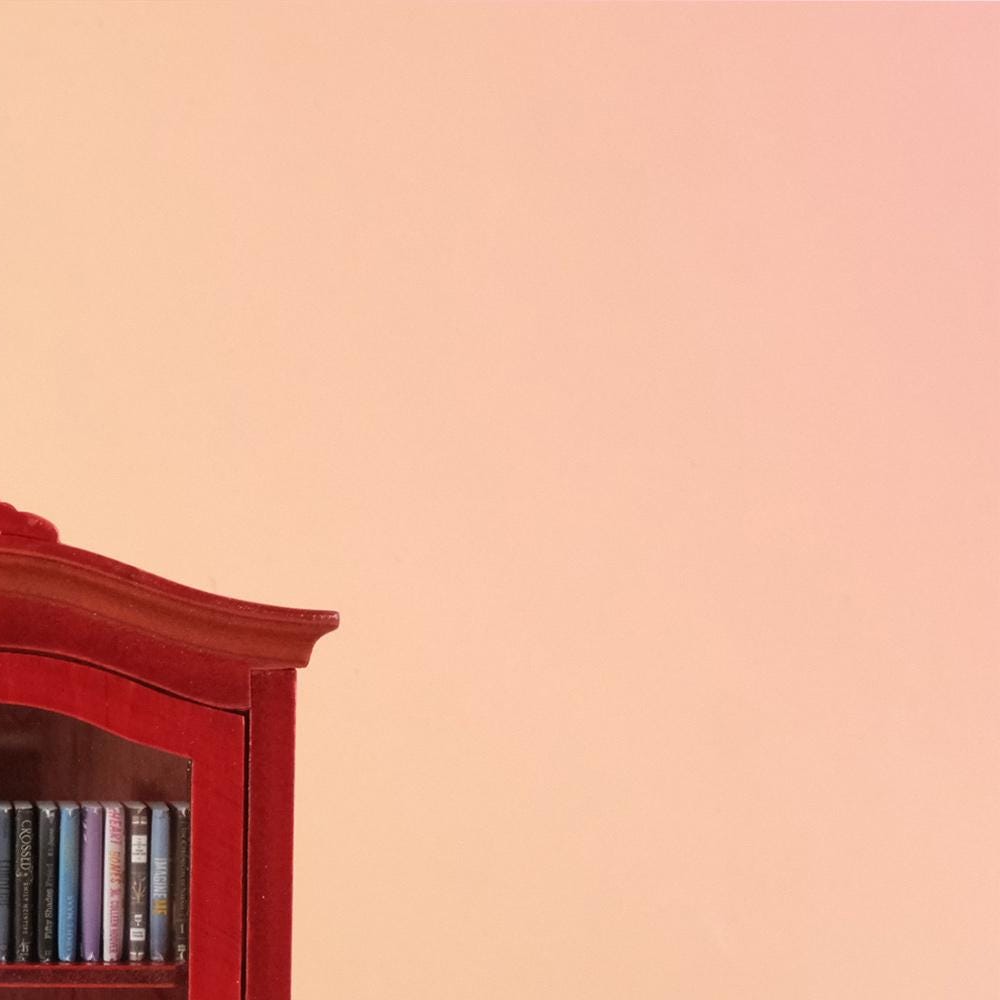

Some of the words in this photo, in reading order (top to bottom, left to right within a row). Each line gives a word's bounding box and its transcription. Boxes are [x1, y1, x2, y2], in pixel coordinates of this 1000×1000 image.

[109, 811, 121, 844] HEART
[18, 819, 32, 871] CROSSED
[152, 857, 168, 899] IMAGINE
[44, 888, 54, 919] Shades
[152, 899, 168, 916] ME
[44, 919, 54, 940] Fifty
